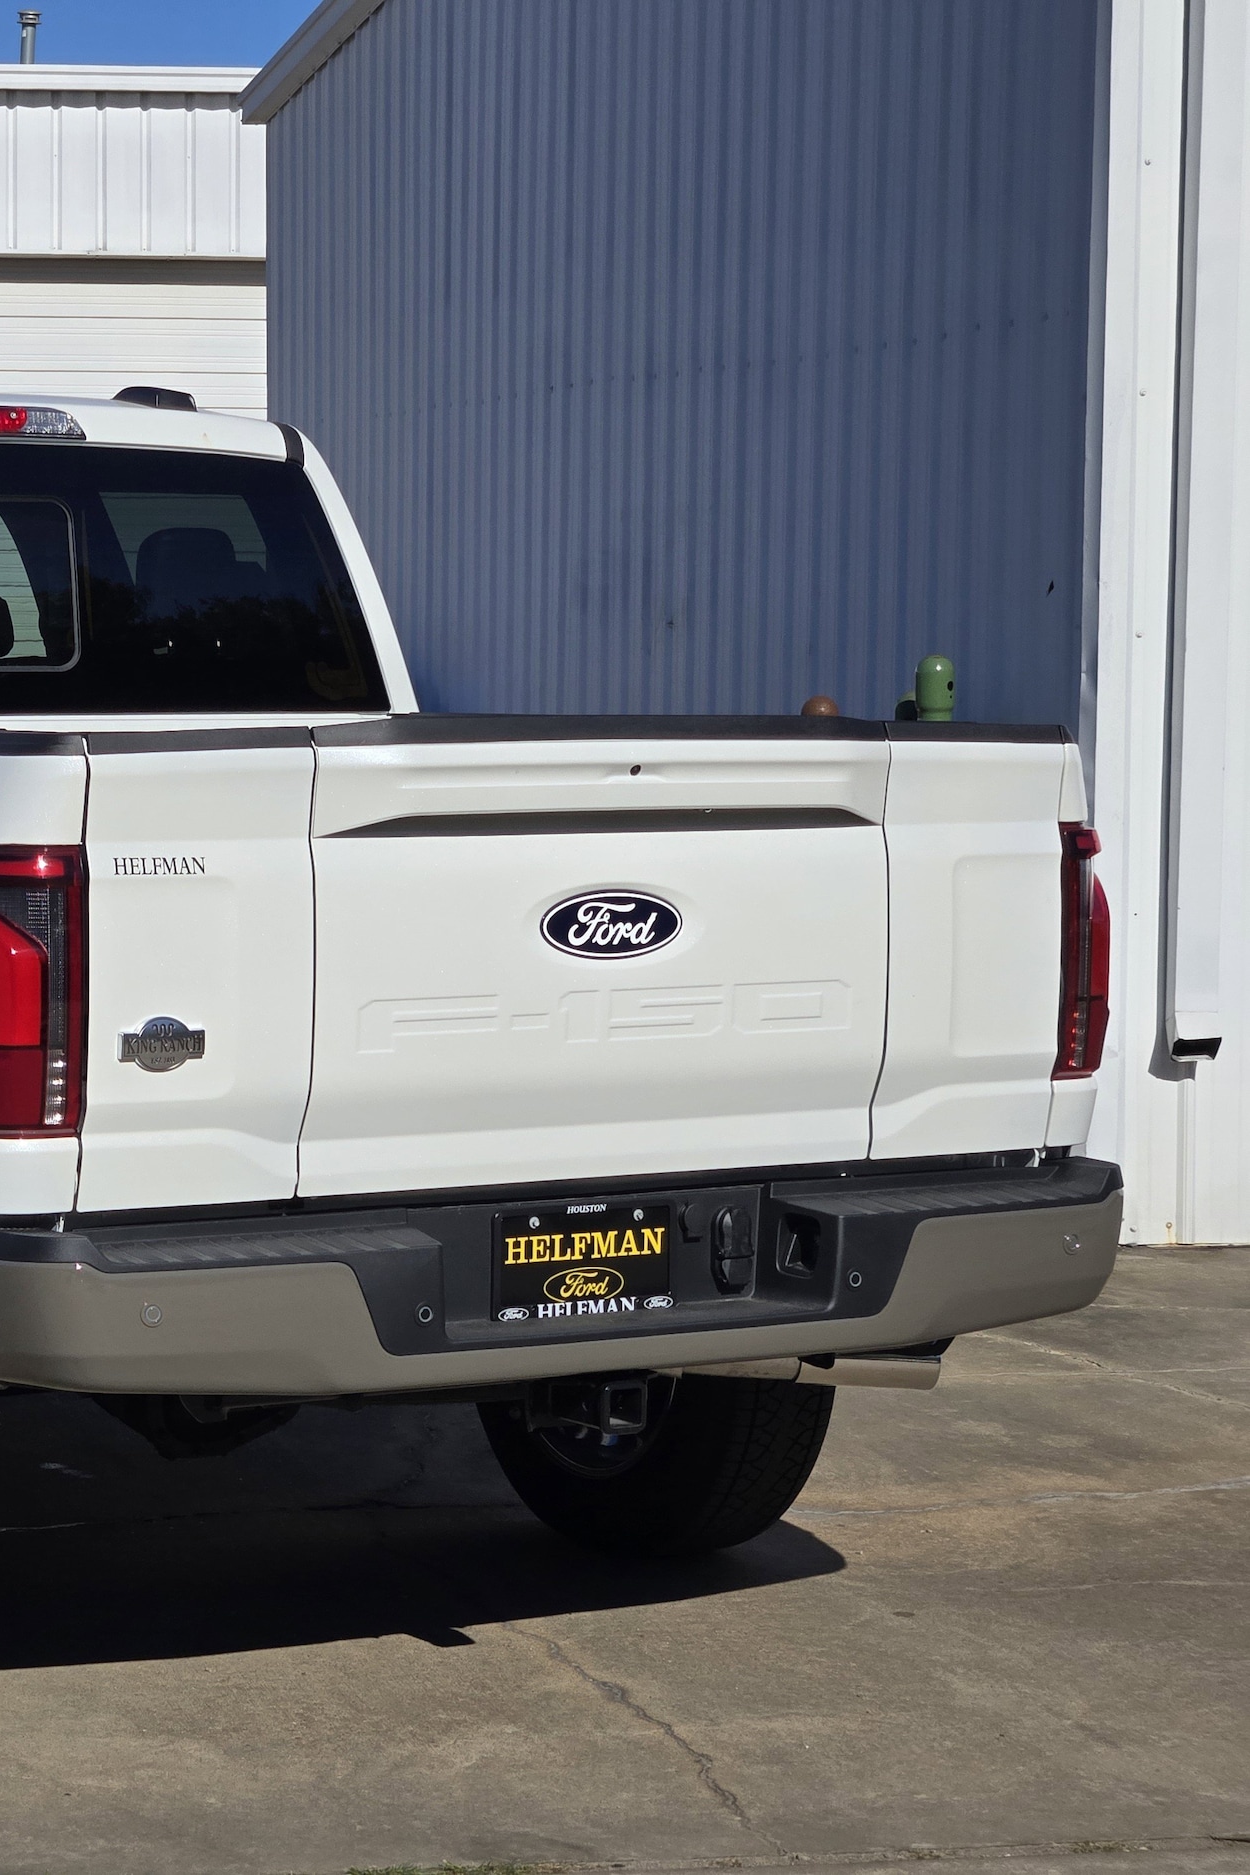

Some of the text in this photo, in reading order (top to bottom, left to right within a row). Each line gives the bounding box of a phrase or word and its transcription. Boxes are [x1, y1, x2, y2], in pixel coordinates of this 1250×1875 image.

[113, 857, 205, 875] HELFMAN
[568, 902, 657, 946] Ford
[356, 979, 851, 1053] F-150
[127, 1034, 202, 1054] KING RANCH
[566, 1203, 607, 1214] HOUSTON
[504, 1227, 665, 1265] HELFMAN
[560, 1272, 609, 1298] Ford
[537, 1297, 637, 1318] HELFMAN
